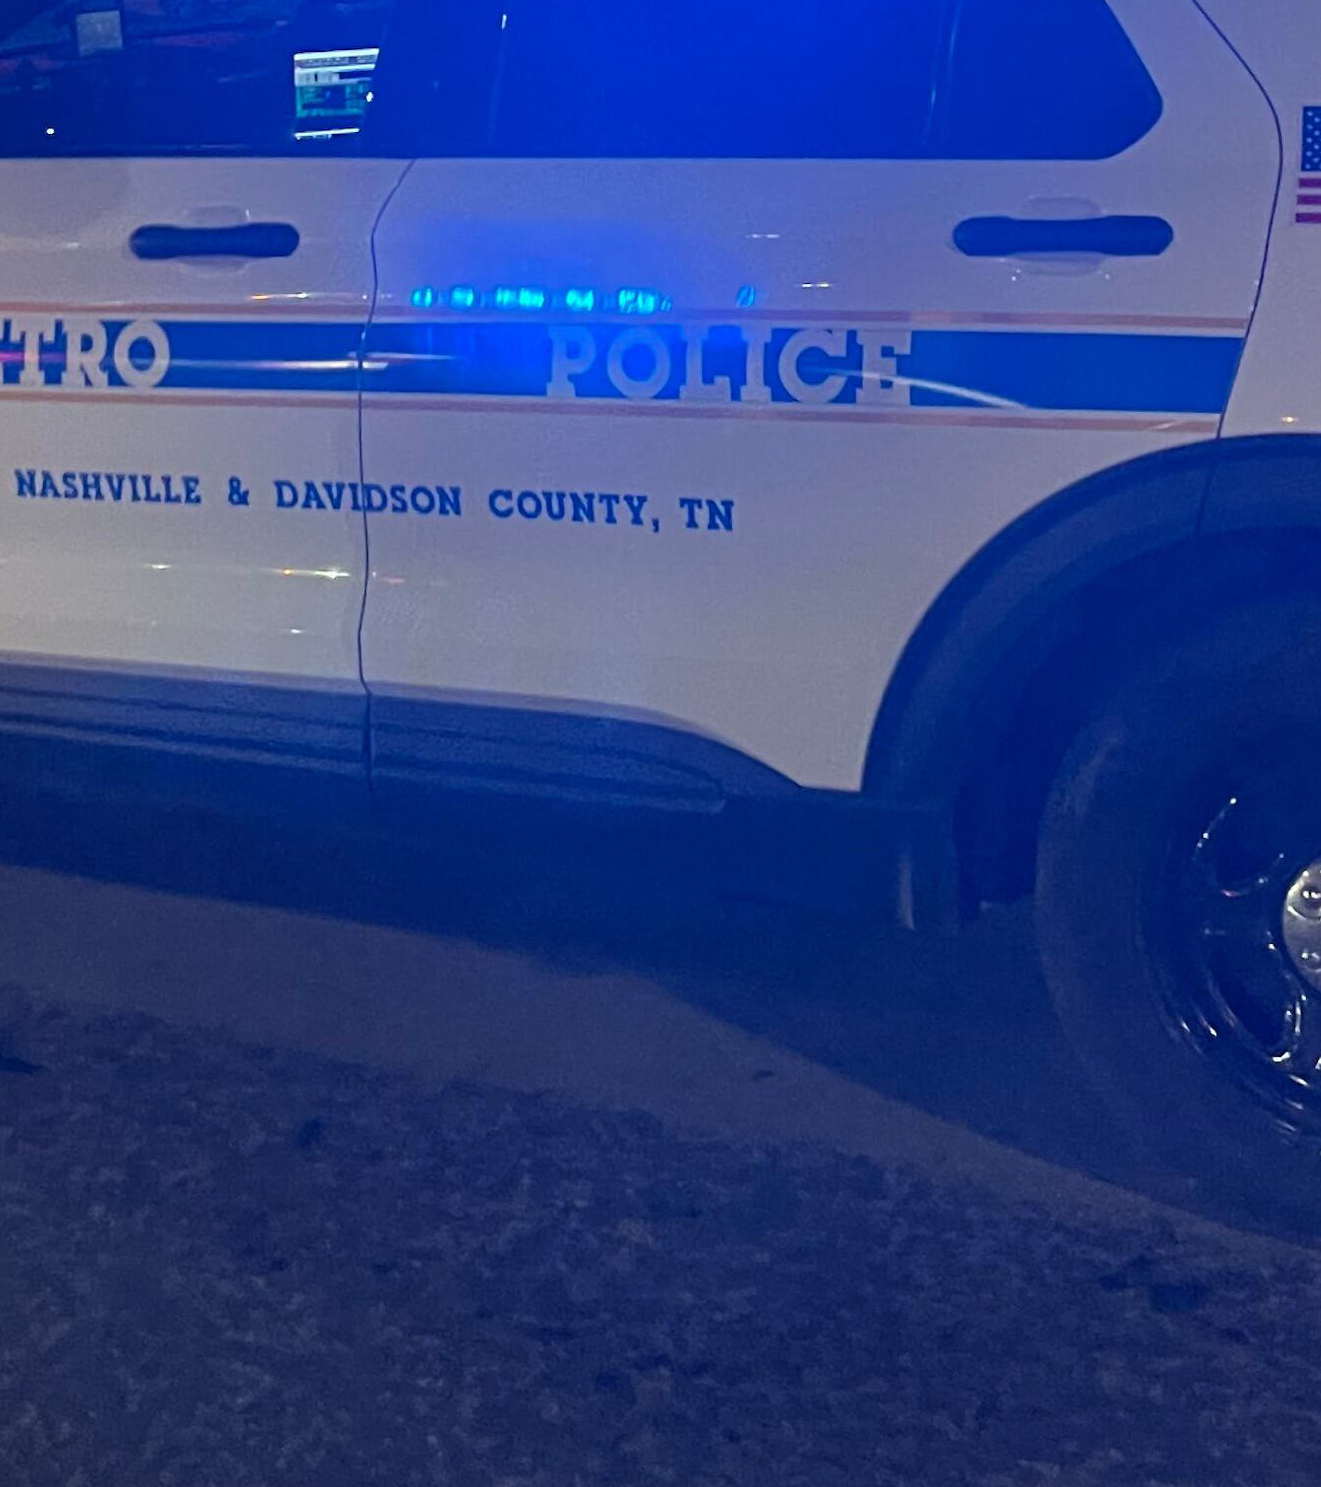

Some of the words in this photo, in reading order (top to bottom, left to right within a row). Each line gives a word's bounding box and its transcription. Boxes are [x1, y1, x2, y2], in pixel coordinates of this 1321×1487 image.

[546, 325, 912, 404] POLICE
[14, 469, 202, 504] NASHVILLE
[227, 476, 249, 505] &
[273, 480, 462, 516] DAVIDSON
[488, 489, 660, 533] COUNTY,
[679, 498, 734, 532] TN
